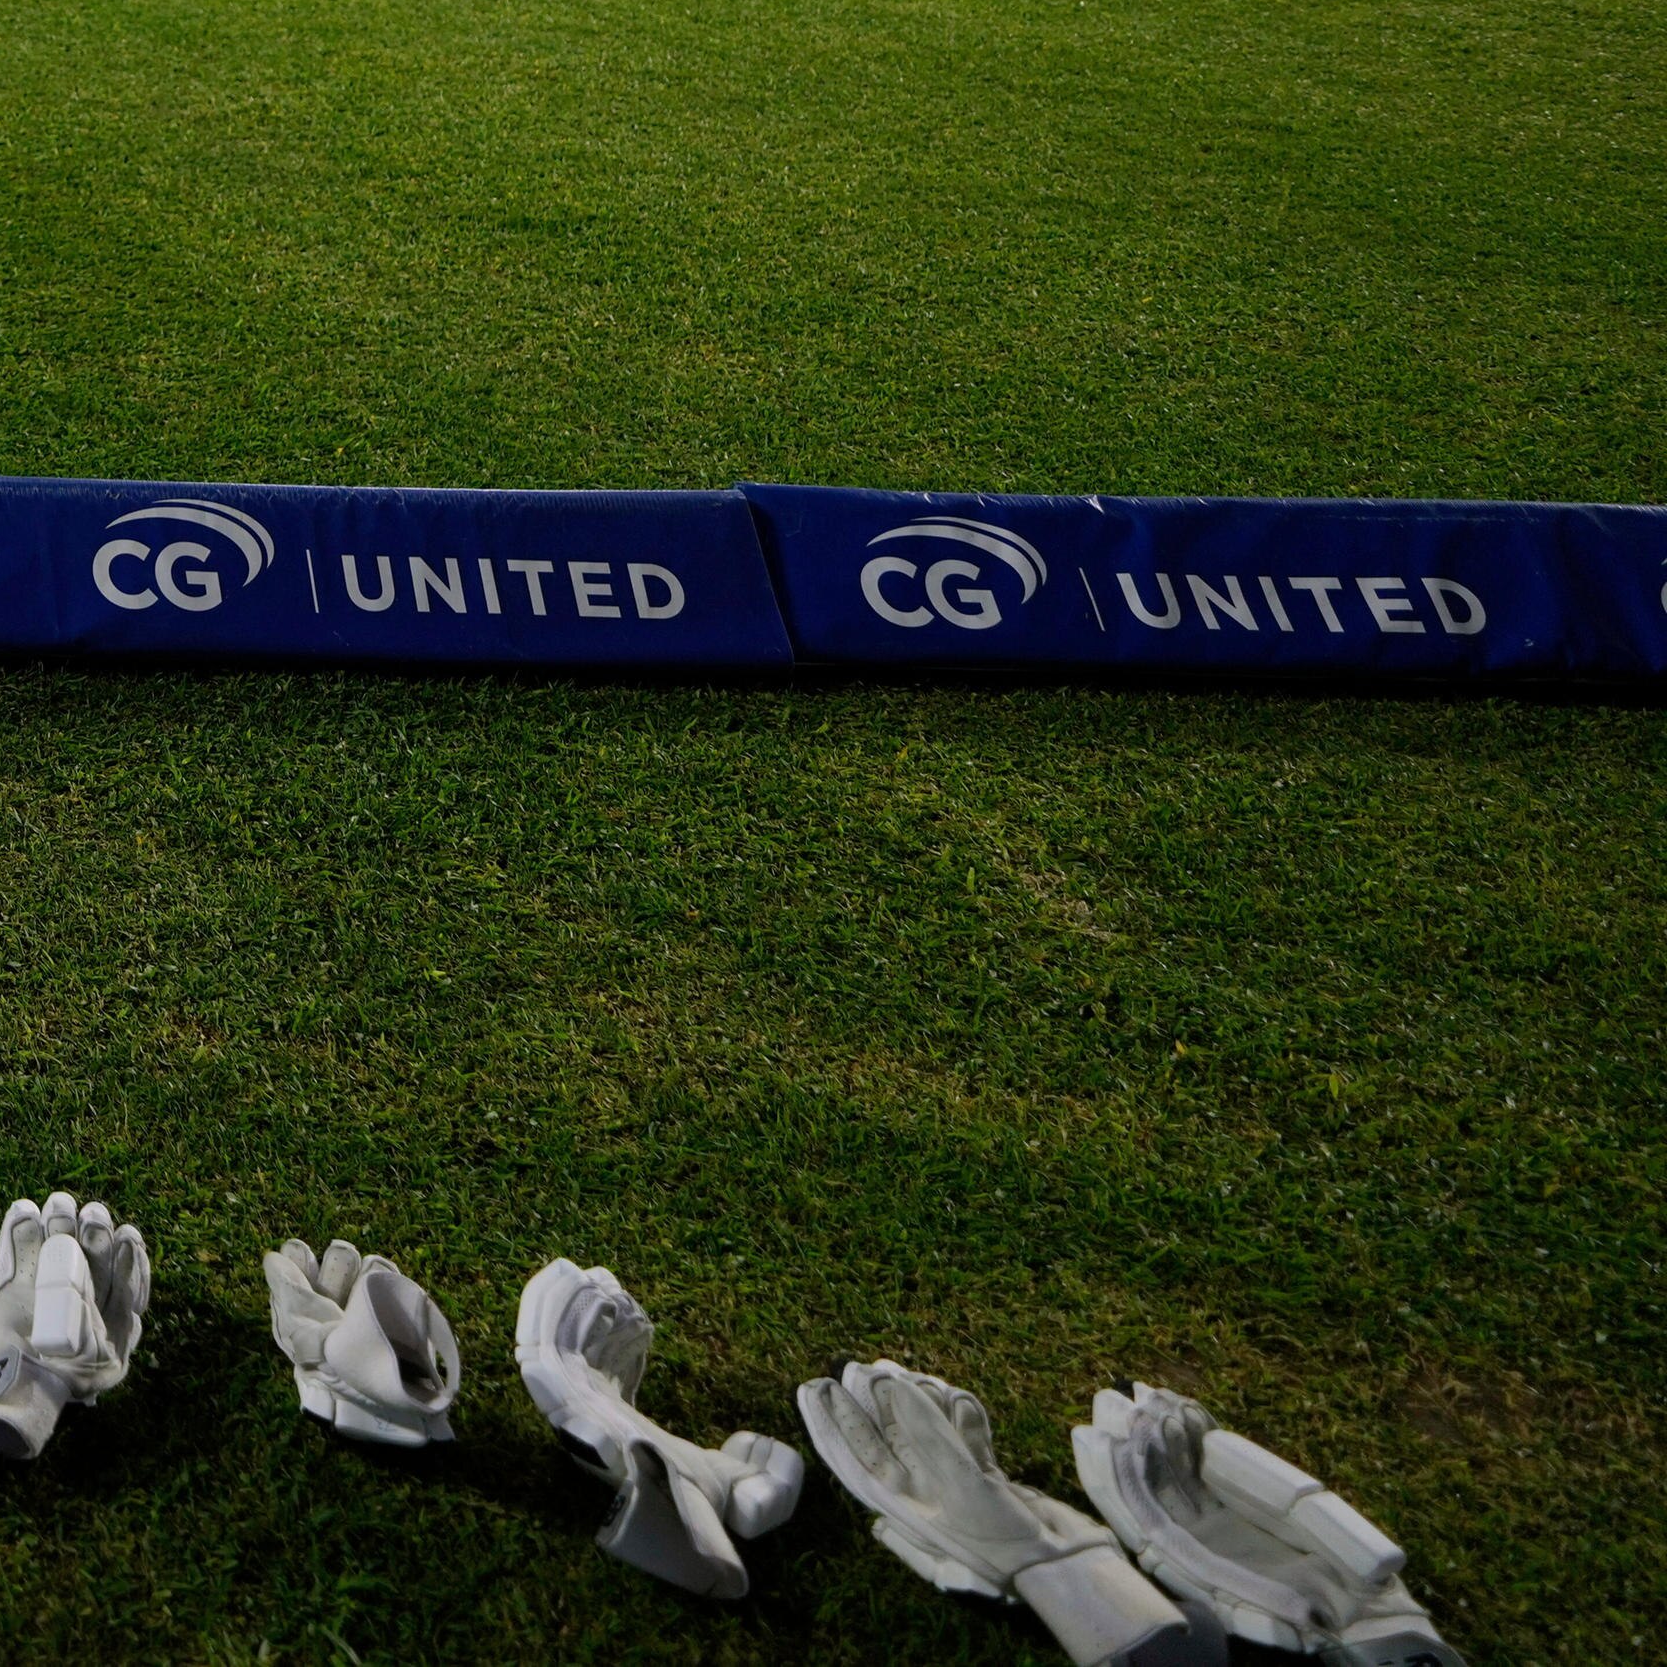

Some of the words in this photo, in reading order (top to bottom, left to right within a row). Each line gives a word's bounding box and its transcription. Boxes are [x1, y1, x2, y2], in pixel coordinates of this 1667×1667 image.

[92, 538, 223, 613] CG
[341, 554, 687, 621] UNITED
[860, 555, 1003, 631] CG
[1116, 570, 1487, 637] UNITED
